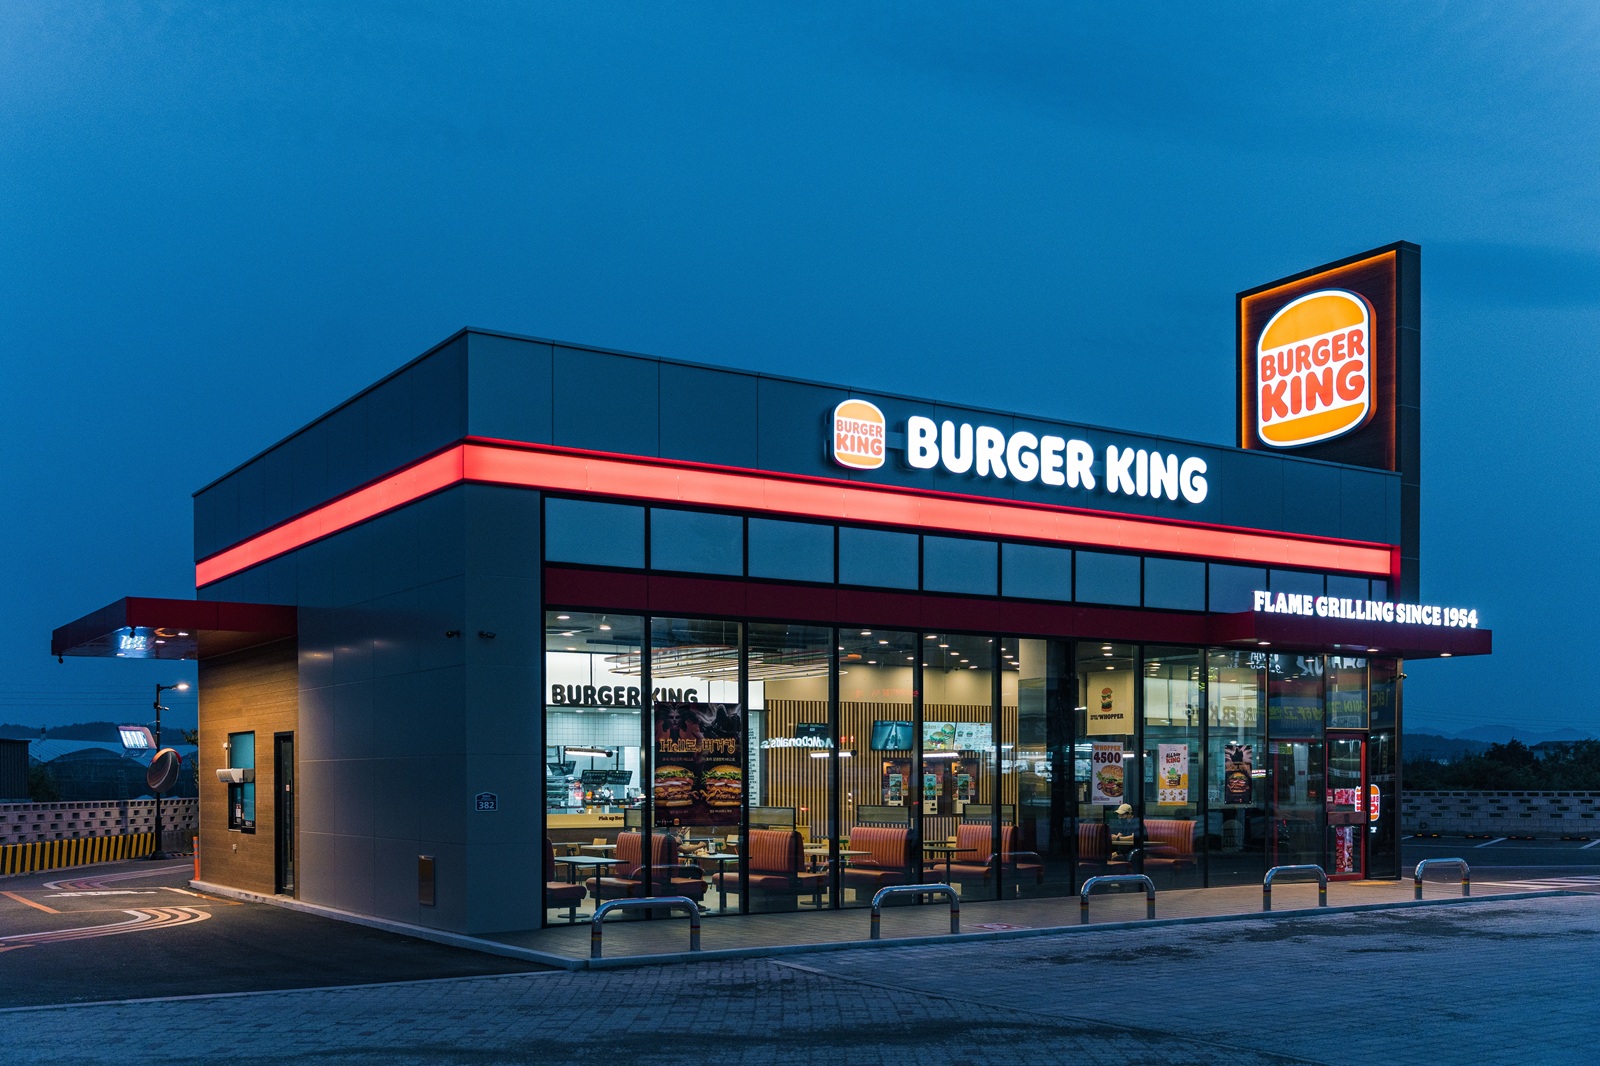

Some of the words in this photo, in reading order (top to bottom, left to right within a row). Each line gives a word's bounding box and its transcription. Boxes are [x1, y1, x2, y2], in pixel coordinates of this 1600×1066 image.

[1261, 329, 1365, 382] BURGER
[1261, 359, 1366, 422] KING
[836, 419, 883, 438] BURGER
[836, 432, 883, 456] KING
[907, 415, 1096, 490] BURGER
[1105, 444, 1208, 504] KING
[1253, 590, 1314, 616] FLAME
[1315, 596, 1394, 622] GRILLING
[1395, 603, 1442, 626] SINCE
[1443, 607, 1479, 629] 1954
[551, 683, 641, 706] BURGER
[702, 738, 736, 755] 버거킹
[1093, 751, 1121, 764] 4500
[478, 801, 495, 809] 382
